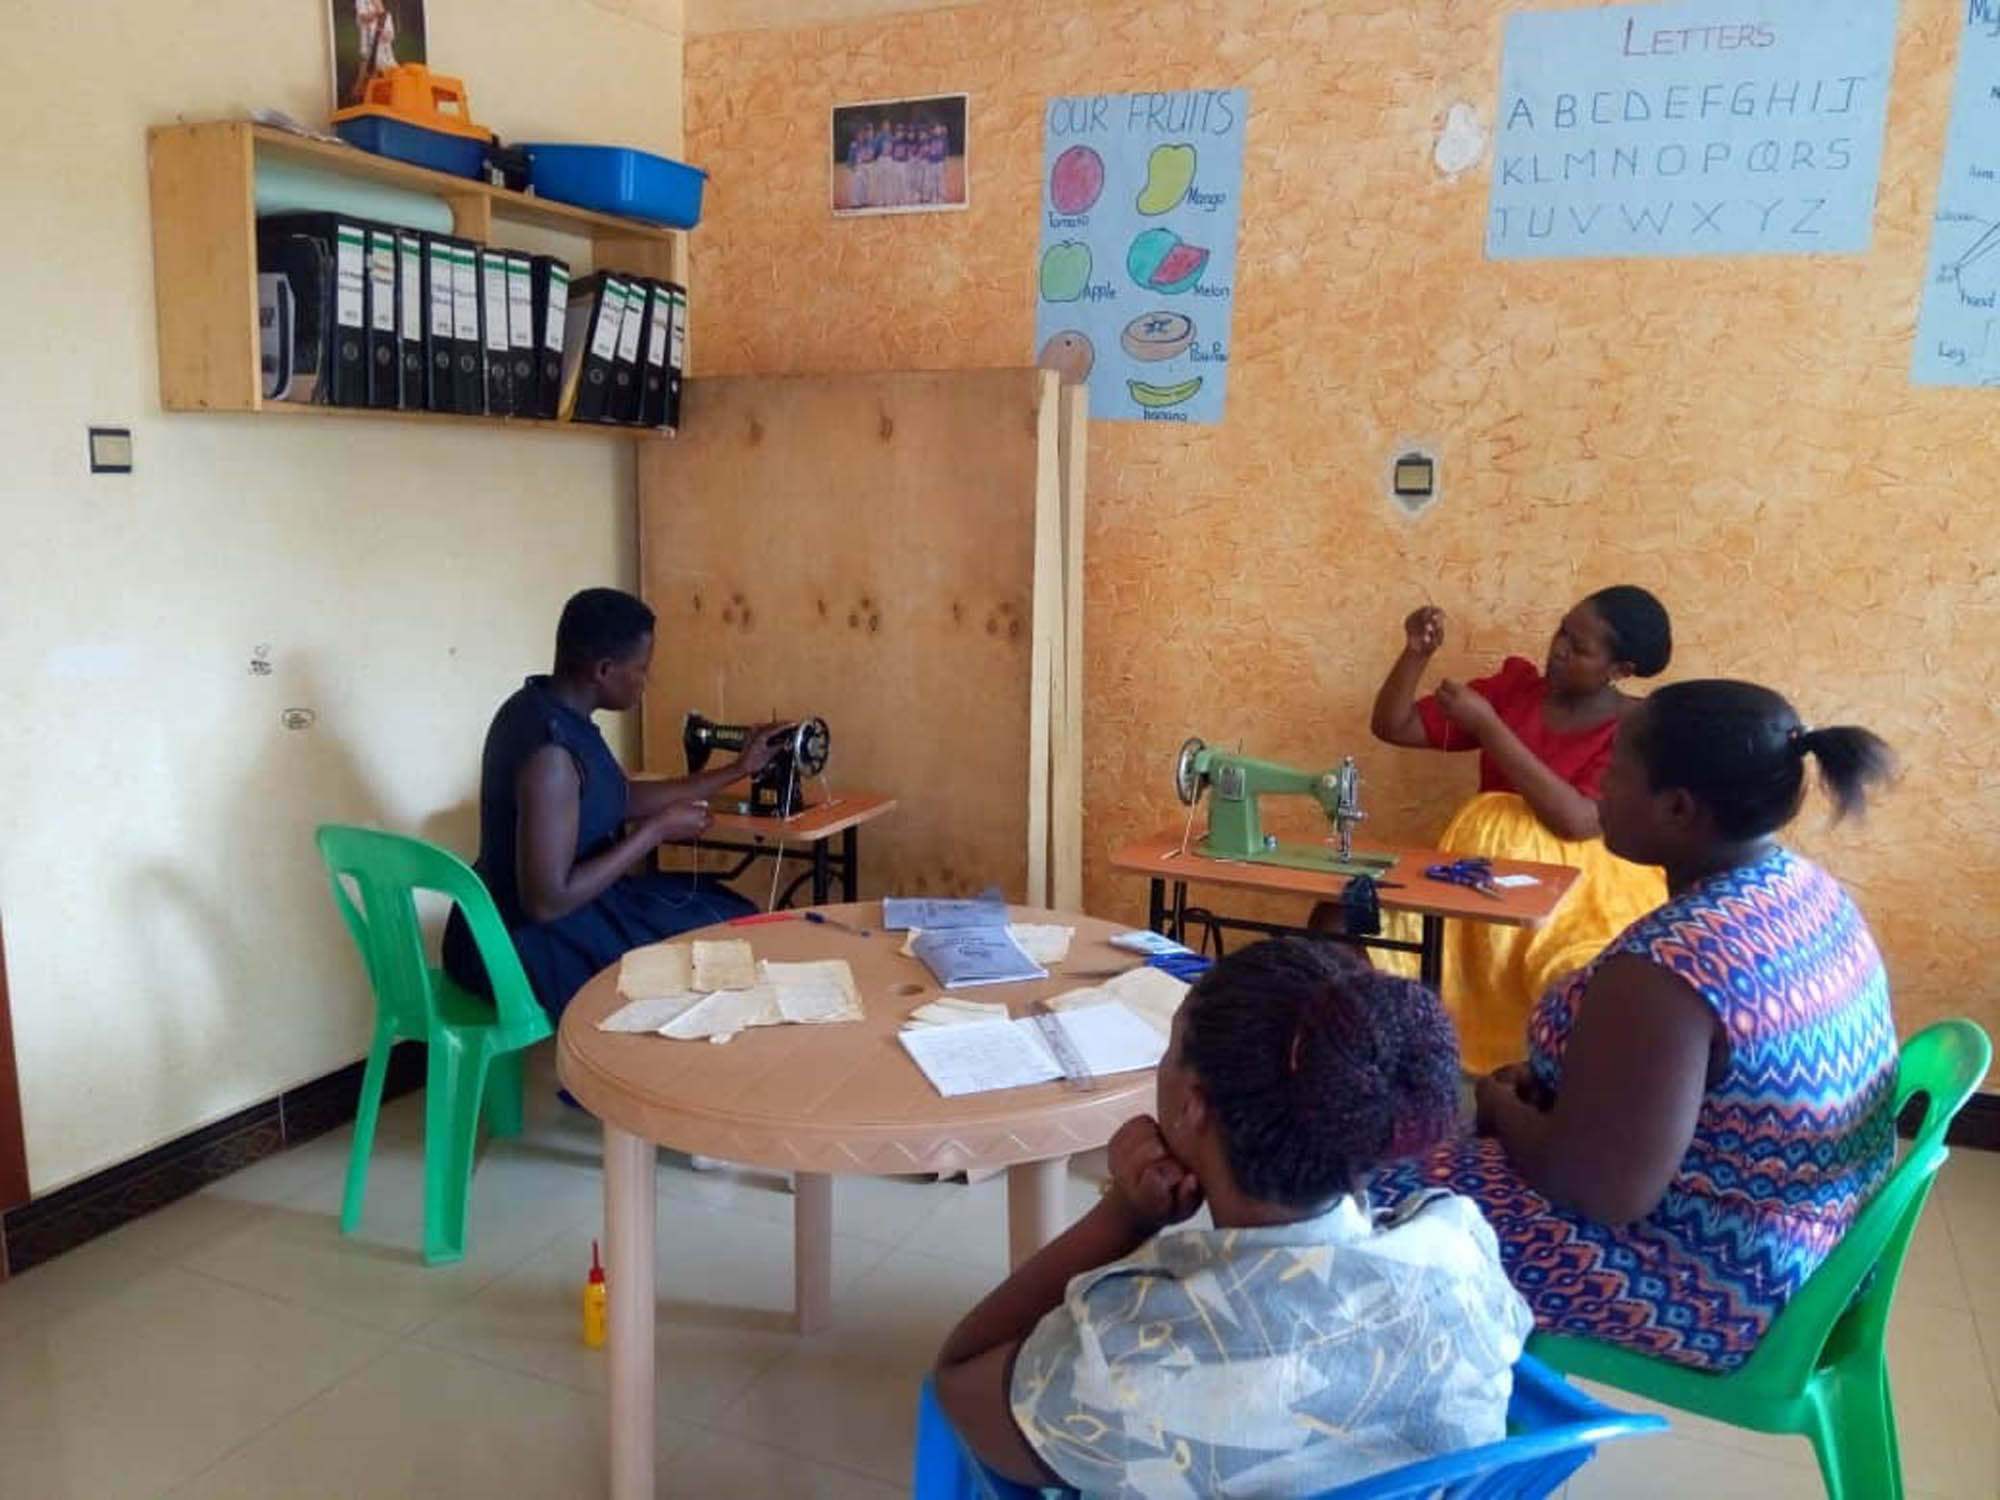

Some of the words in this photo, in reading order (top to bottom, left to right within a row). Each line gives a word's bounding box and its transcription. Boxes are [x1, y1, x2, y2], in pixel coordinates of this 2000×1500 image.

[1623, 17, 1775, 56] LETTERS
[1050, 96, 1108, 136] OUR
[1127, 91, 1234, 135] FRUITS
[1082, 280, 1117, 302] Apple
